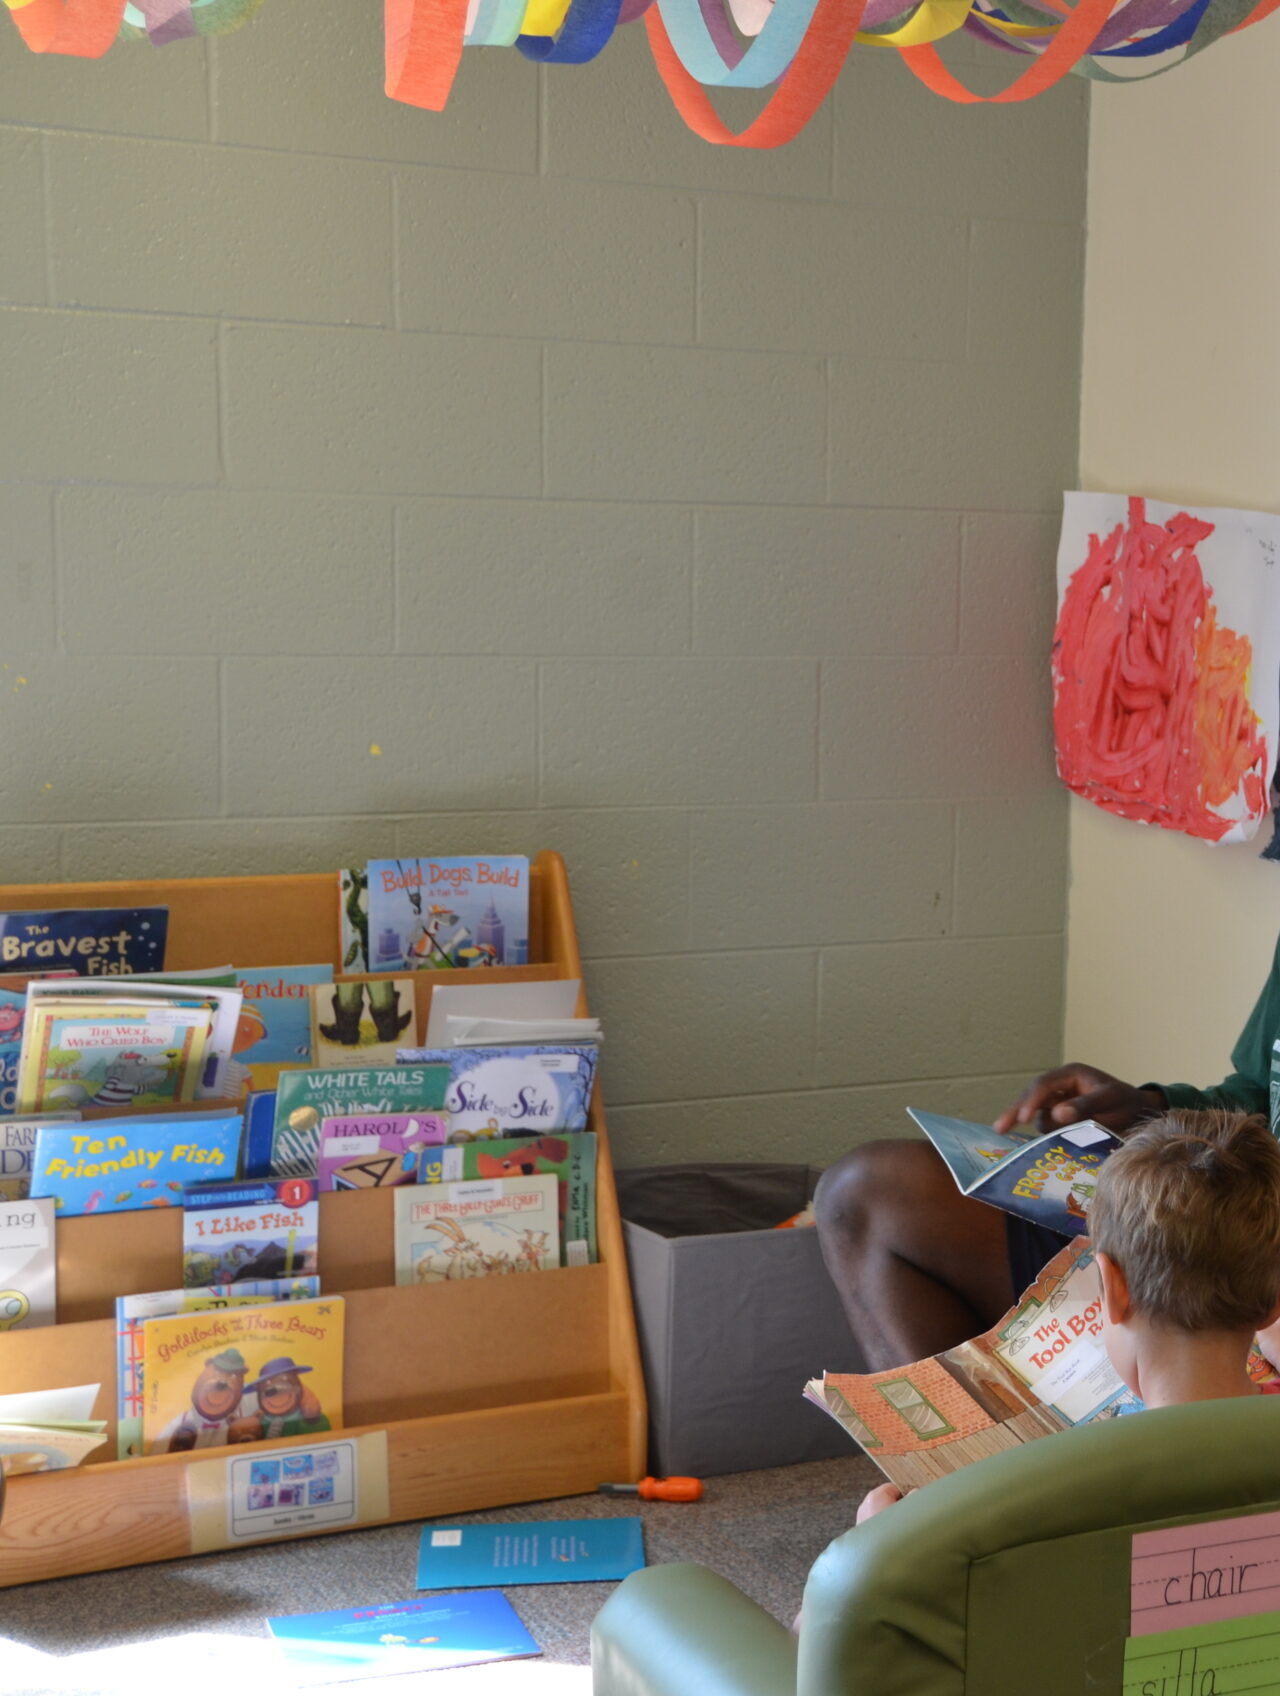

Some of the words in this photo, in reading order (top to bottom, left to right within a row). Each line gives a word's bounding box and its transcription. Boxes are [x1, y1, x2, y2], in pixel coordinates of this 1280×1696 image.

[475, 862, 520, 888] Build
[25, 925, 50, 936] The
[2, 930, 132, 962] Bravest
[87, 956, 133, 976] Fish
[66, 1037, 99, 1048] WHO
[101, 1036, 139, 1047] CRIED
[141, 1035, 167, 1045] BOY
[88, 1026, 111, 1037] THE
[115, 1026, 149, 1036] WOLF
[307, 1071, 370, 1089] WHITE
[375, 1070, 425, 1086] TAILS
[304, 1090, 324, 1101] and
[328, 1087, 360, 1099] Other
[361, 1086, 395, 1098] White
[447, 1080, 494, 1114] Side
[508, 1086, 555, 1119] Side
[5, 1125, 37, 1147] FAR
[70, 1133, 128, 1155] Ten
[45, 1148, 165, 1180] Friendly
[170, 1143, 226, 1166] Fish
[1012, 1145, 1073, 1200] FROGGY
[1055, 1160, 1086, 1182] GOES
[1080, 1154, 1100, 1163] TO
[191, 1194, 213, 1205] STEP
[226, 1189, 267, 1201] READING
[293, 1186, 301, 1201] 1
[415, 1204, 432, 1219] THE
[434, 1202, 458, 1217] THREE
[513, 1194, 540, 1211] GRUFF
[195, 1220, 206, 1236] I
[210, 1216, 257, 1235] Like
[260, 1211, 305, 1230] Fish
[157, 1320, 229, 1362] Goldilocks
[243, 1313, 284, 1332] Three
[286, 1316, 327, 1341] Bears
[1034, 1318, 1060, 1342] The
[1029, 1329, 1073, 1370] Tool
[1164, 1547, 1258, 1606] chair
[1142, 1647, 1222, 1696] silla
